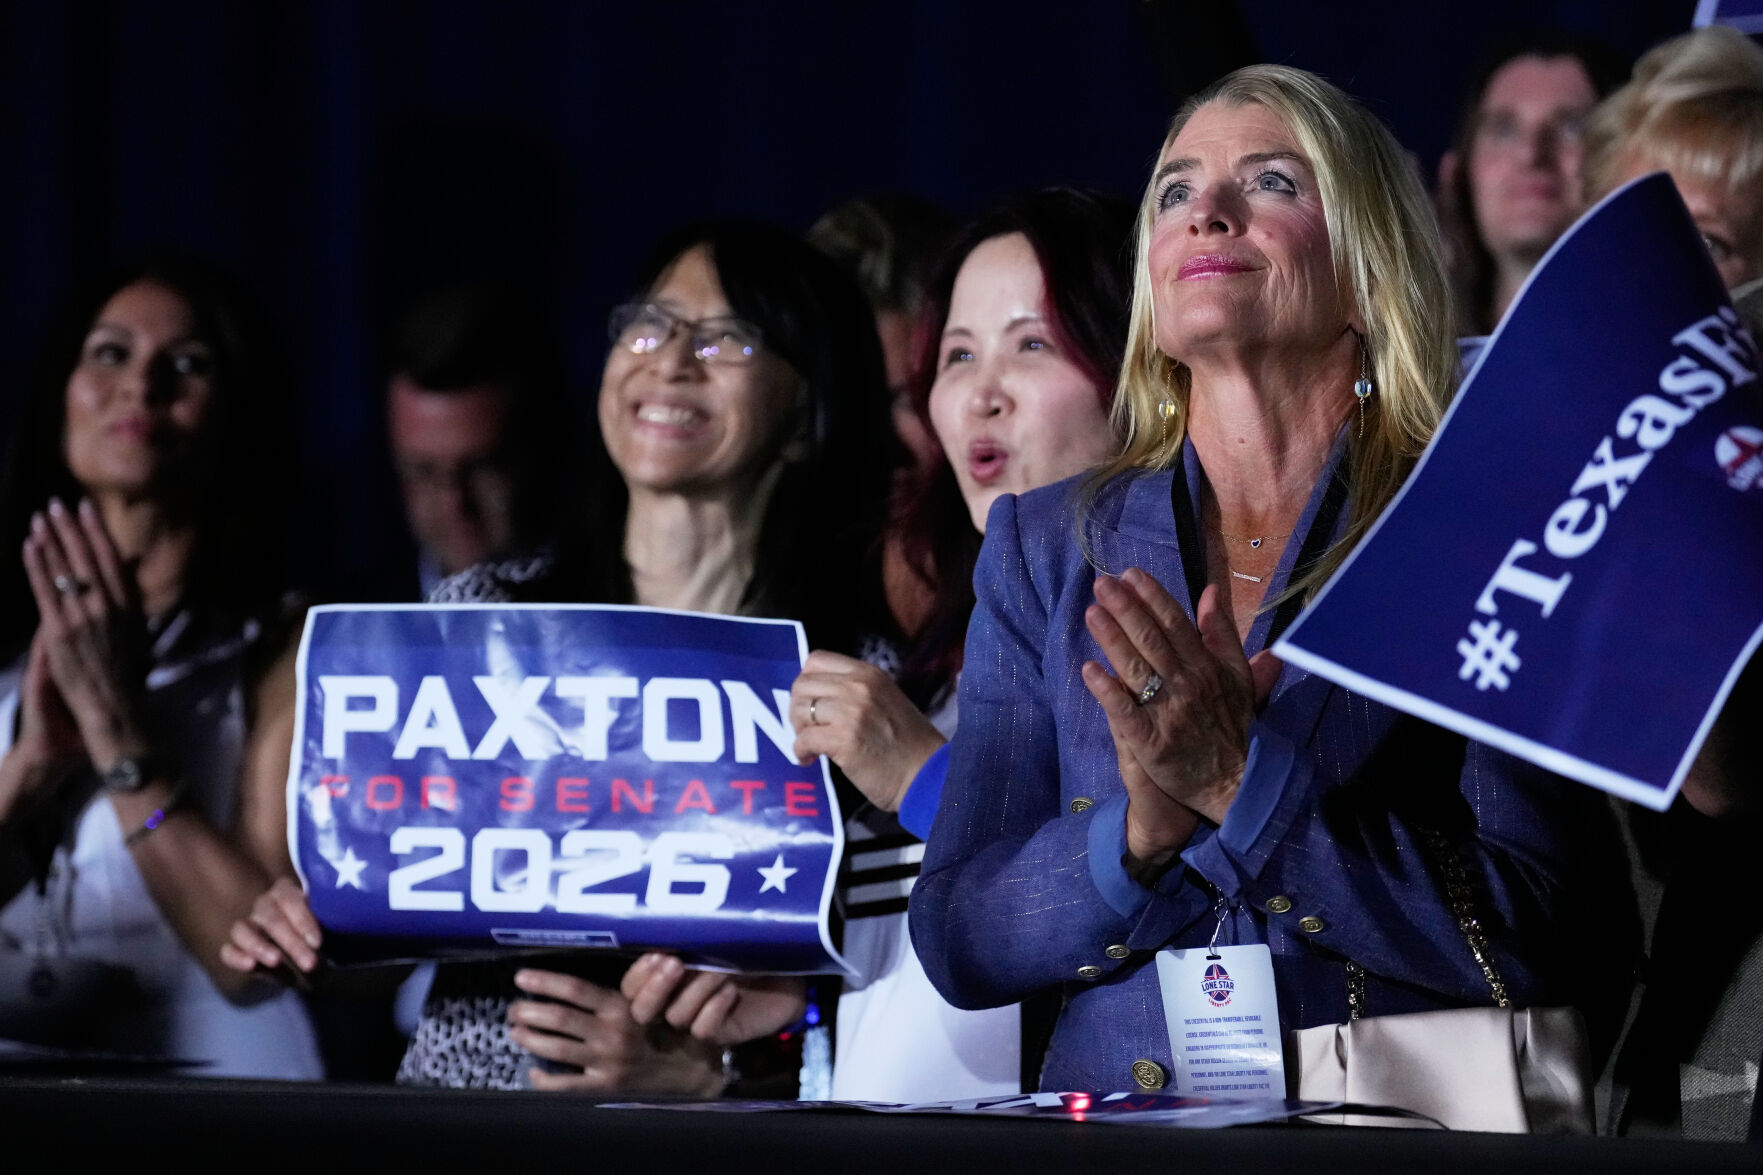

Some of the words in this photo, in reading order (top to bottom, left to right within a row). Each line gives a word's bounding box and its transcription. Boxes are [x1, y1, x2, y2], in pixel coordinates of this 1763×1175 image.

[318, 673, 802, 766] PAXTON
[320, 774, 458, 811] FOR
[495, 776, 818, 817] SENATE
[388, 826, 735, 913] 2026
[1201, 981, 1217, 992] LONE
[1218, 980, 1235, 990] STAR
